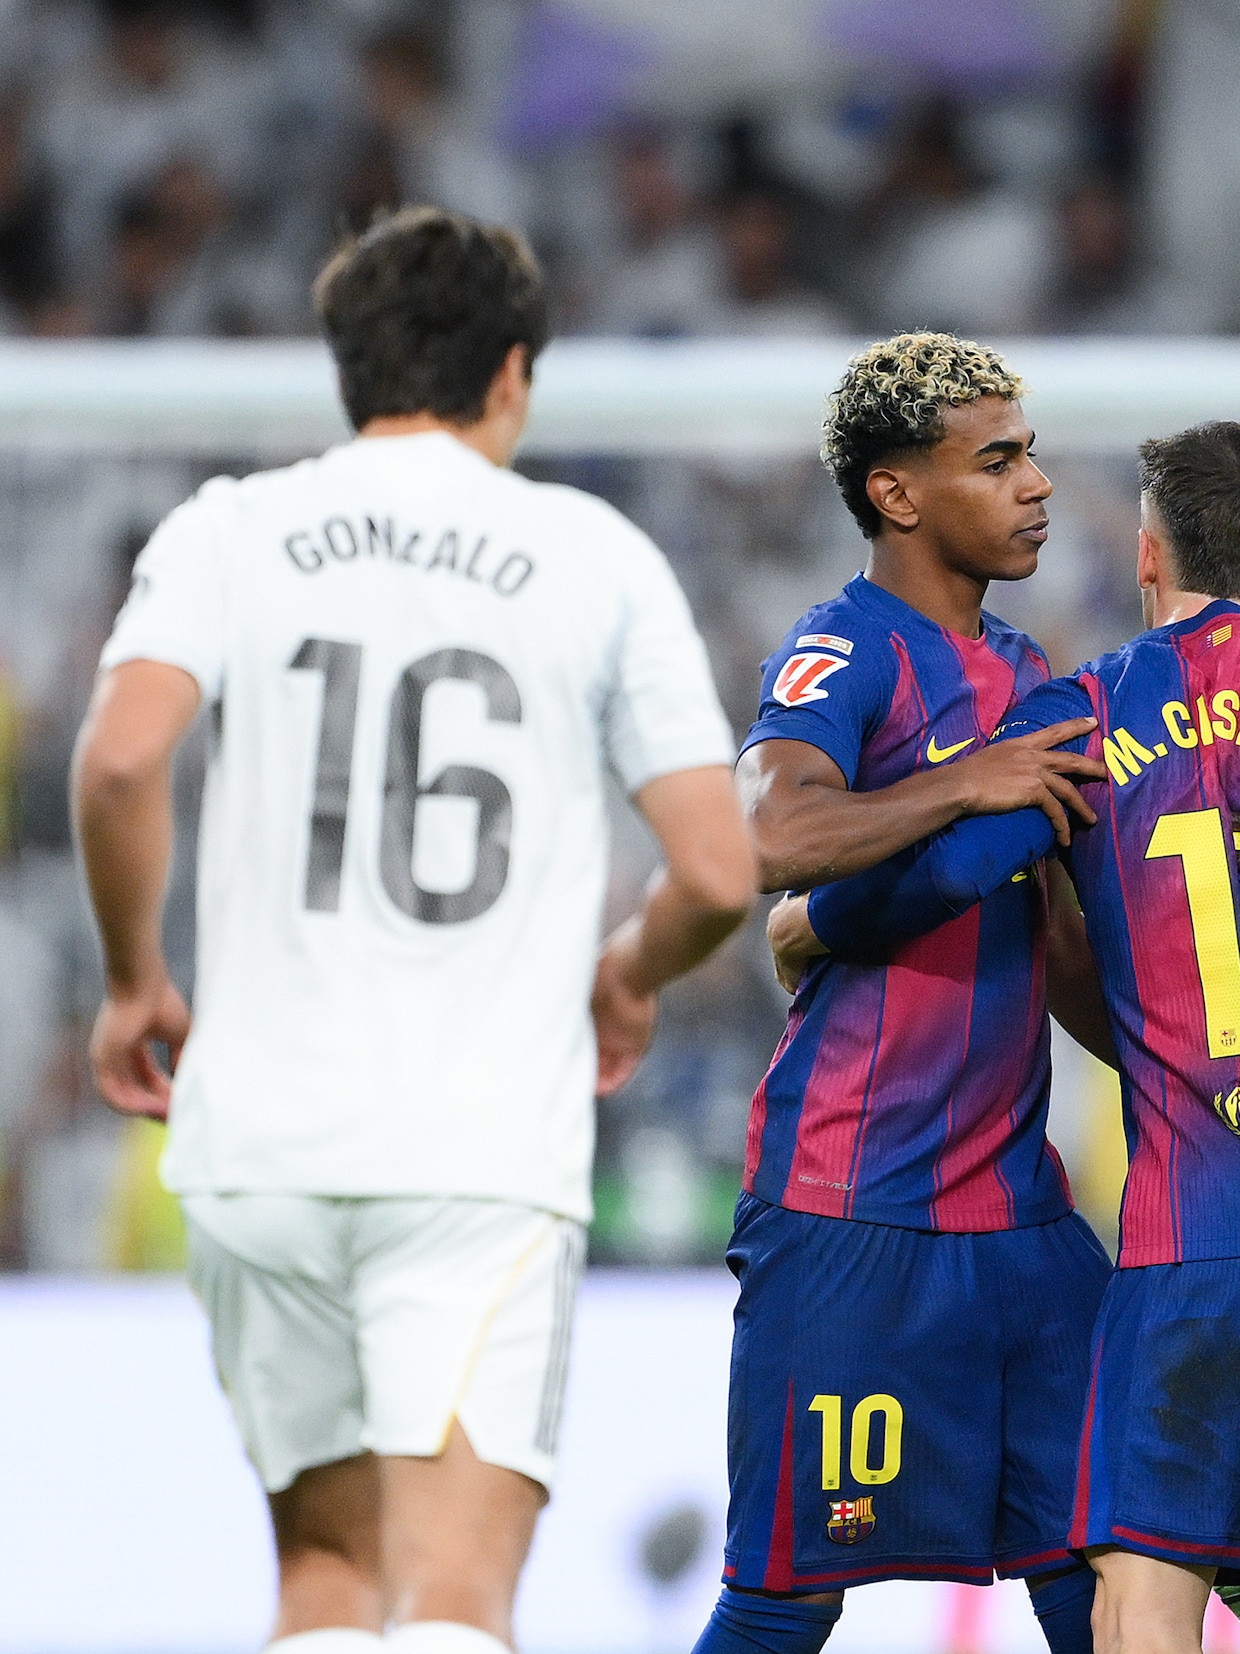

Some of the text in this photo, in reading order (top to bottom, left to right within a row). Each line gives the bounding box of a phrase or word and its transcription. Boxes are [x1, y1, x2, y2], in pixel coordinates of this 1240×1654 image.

[287, 637, 522, 925] 16
[1102, 727, 1168, 787] M.
[807, 1392, 904, 1491] 10
